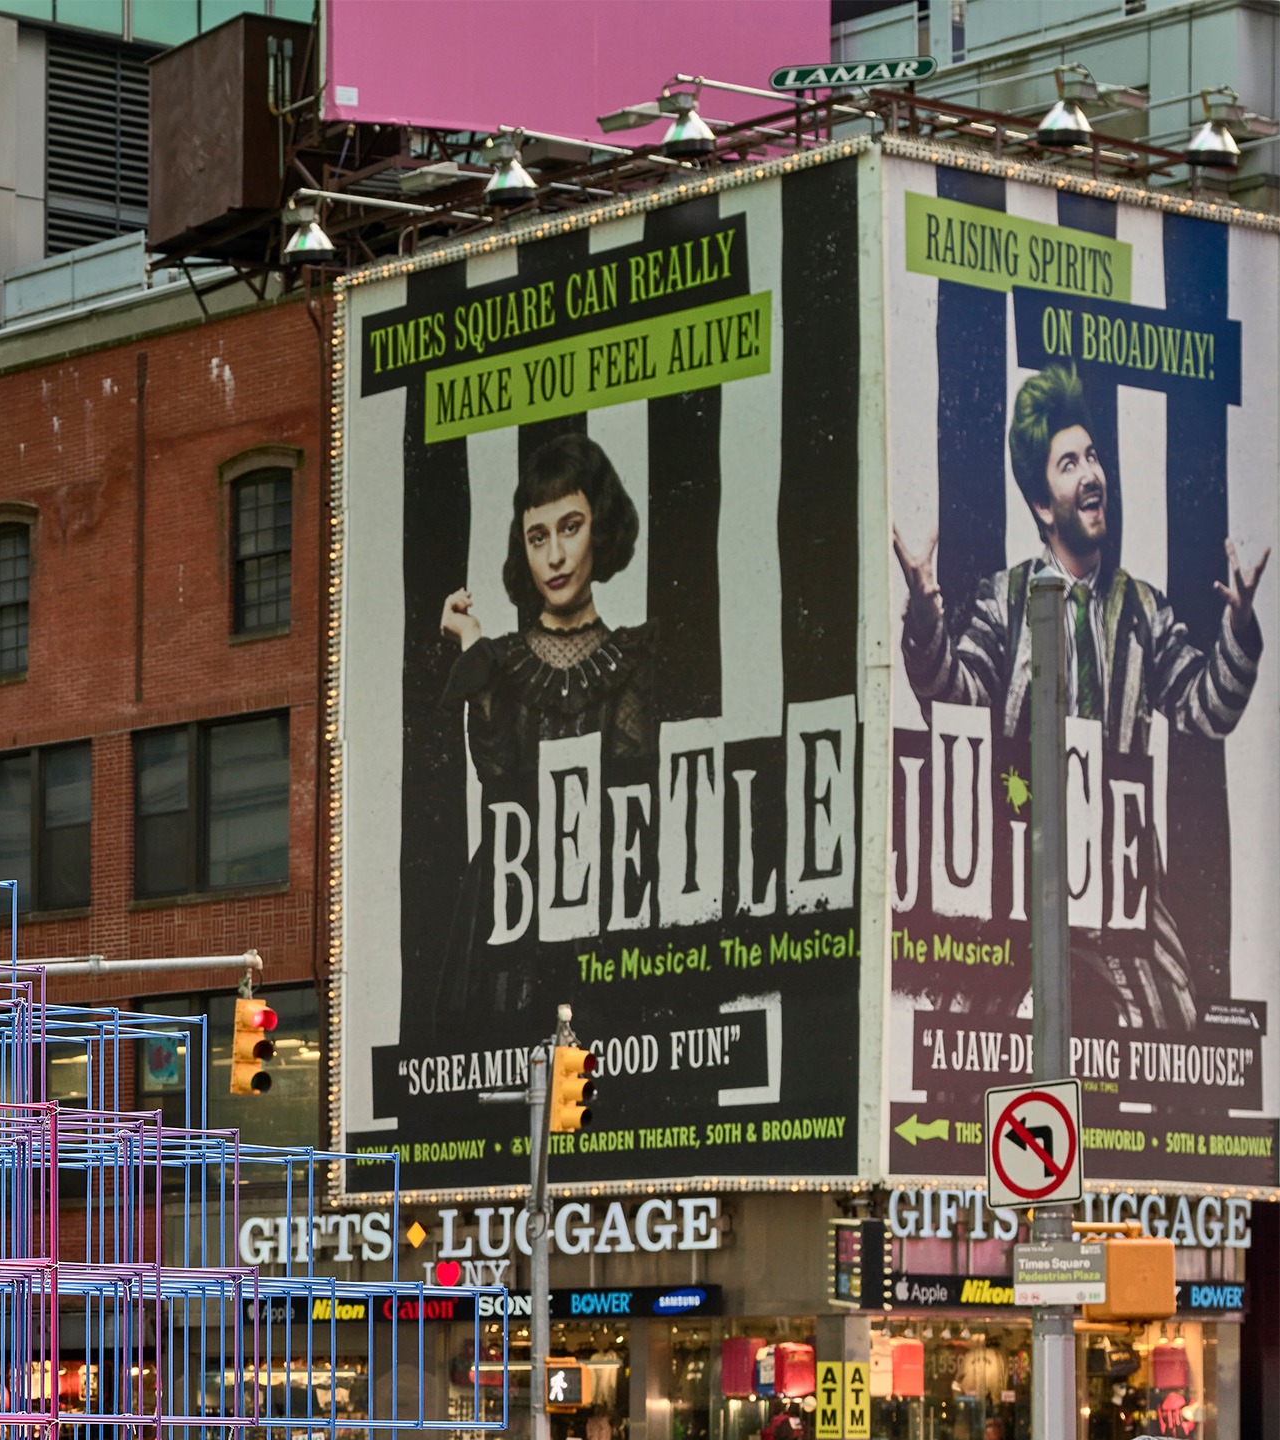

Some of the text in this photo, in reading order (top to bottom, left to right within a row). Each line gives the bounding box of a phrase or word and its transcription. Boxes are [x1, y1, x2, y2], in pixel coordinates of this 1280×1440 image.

[783, 60, 919, 86] LAMAR
[925, 212, 1114, 297] RAISING SPIRITS
[370, 229, 736, 374] TIMES SQUARE CAN REALLY
[435, 308, 761, 425] MAKE YOU FEEL ALIVE!
[1042, 306, 1215, 381] ON BROADWAY!
[487, 729, 843, 946] BEETLE
[578, 928, 861, 983] The Musical. The Musical.
[891, 930, 1015, 967] The Musical.
[590, 1034, 659, 1078] GOOD
[923, 1029, 947, 1071] “A
[1129, 1040, 1253, 1089] FUNHOUSE!”
[356, 1145, 389, 1166] NOW
[396, 1144, 411, 1163] ON
[413, 1139, 486, 1163] BROADWAY
[580, 1130, 635, 1152] GARDEN
[639, 1125, 701, 1150] THEATRE,
[705, 1122, 742, 1145] 50TH
[746, 1122, 757, 1144] &
[762, 1116, 847, 1143] BROADWAY
[955, 1121, 982, 1145] THIS
[1165, 1132, 1195, 1155] 50TH
[1197, 1135, 1207, 1154] &
[1209, 1135, 1273, 1158] BROADWAY
[238, 1197, 719, 1265] GIFTS LUGGAGE
[888, 1189, 1019, 1242] GIFTS
[465, 1259, 511, 1287] NY
[1018, 1257, 1091, 1270] Times Square
[1018, 1270, 1101, 1282] Pedestrian Plaza
[261, 1303, 296, 1322] Apple
[312, 1298, 366, 1321] Nikon
[383, 1298, 456, 1320] Canon
[570, 1292, 632, 1315] BOWER
[658, 1294, 701, 1308] SAMSUNG
[911, 1283, 948, 1306] Apple
[1190, 1285, 1243, 1308] BOWER
[821, 1366, 837, 1427] ATM
[850, 1367, 864, 1427] ATM
